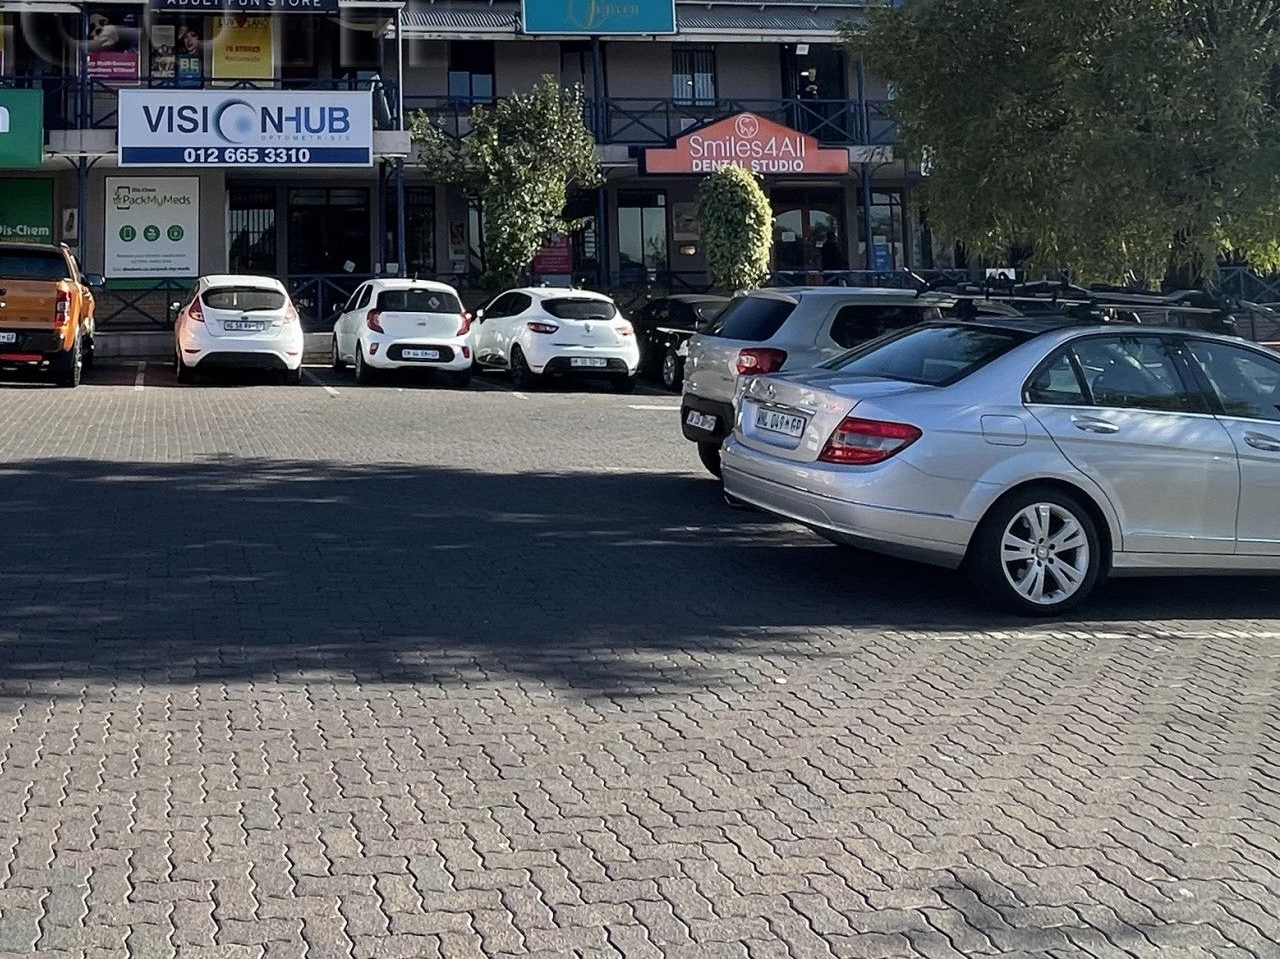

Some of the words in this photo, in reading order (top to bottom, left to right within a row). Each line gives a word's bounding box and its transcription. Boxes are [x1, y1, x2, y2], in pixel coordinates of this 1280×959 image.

[689, 135, 806, 158] Smiles4All
[183, 147, 219, 163] 012
[224, 147, 259, 163] 665
[264, 147, 311, 163] 3310
[750, 159, 804, 172] STUDIO
